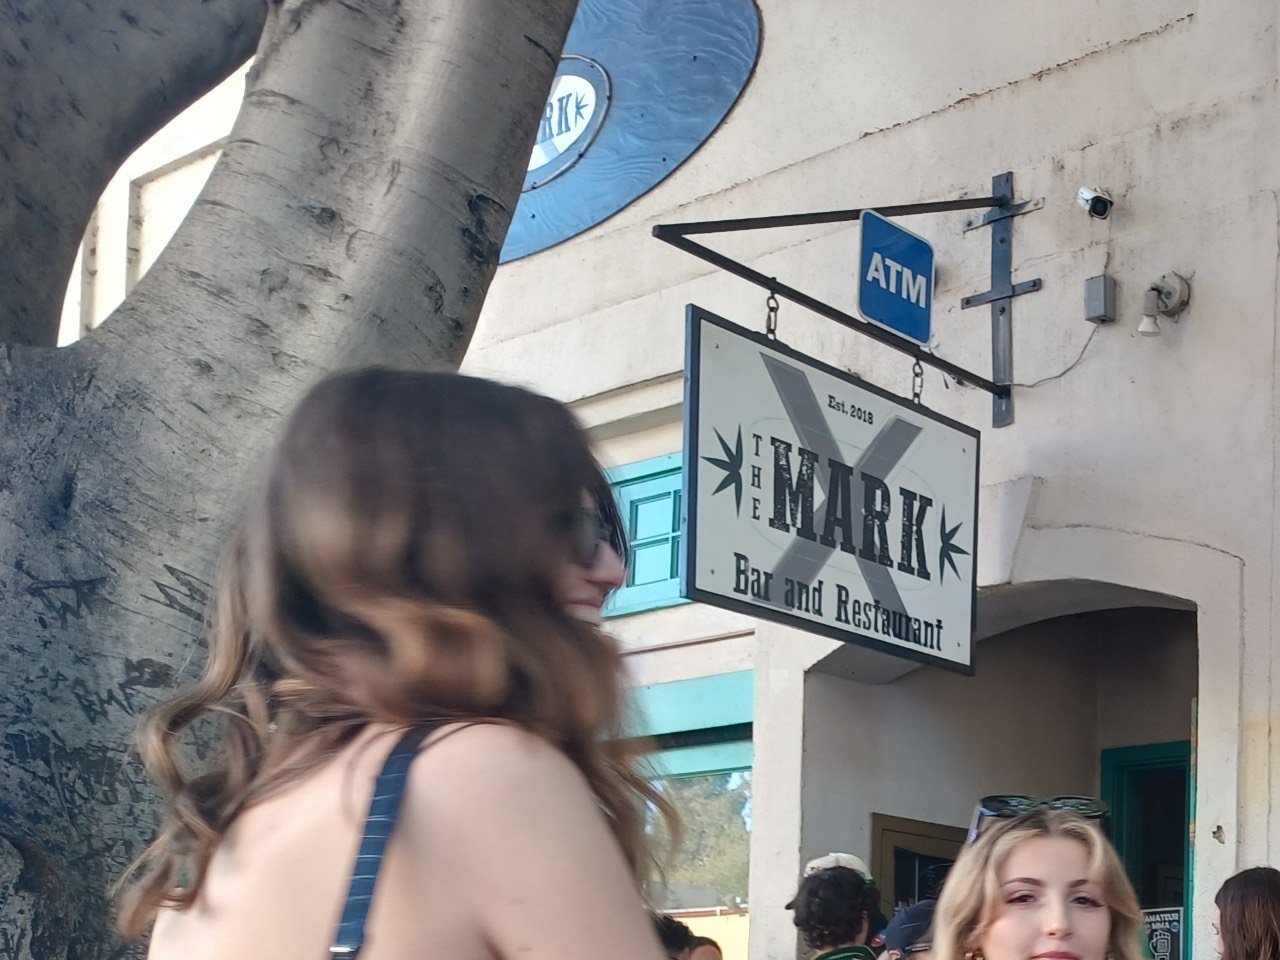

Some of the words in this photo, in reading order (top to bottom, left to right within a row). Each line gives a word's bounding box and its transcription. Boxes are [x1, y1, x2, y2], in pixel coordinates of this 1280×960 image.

[540, 93, 573, 144] RK
[866, 251, 927, 308] ATM
[828, 394, 849, 415] Est.
[850, 404, 874, 425] 2018
[751, 433, 763, 521] THE
[768, 436, 934, 581] MARK
[733, 551, 774, 602] Bar
[784, 579, 824, 617] and
[835, 583, 944, 651] Restaurant
[1145, 913, 1179, 922] AMATEUR
